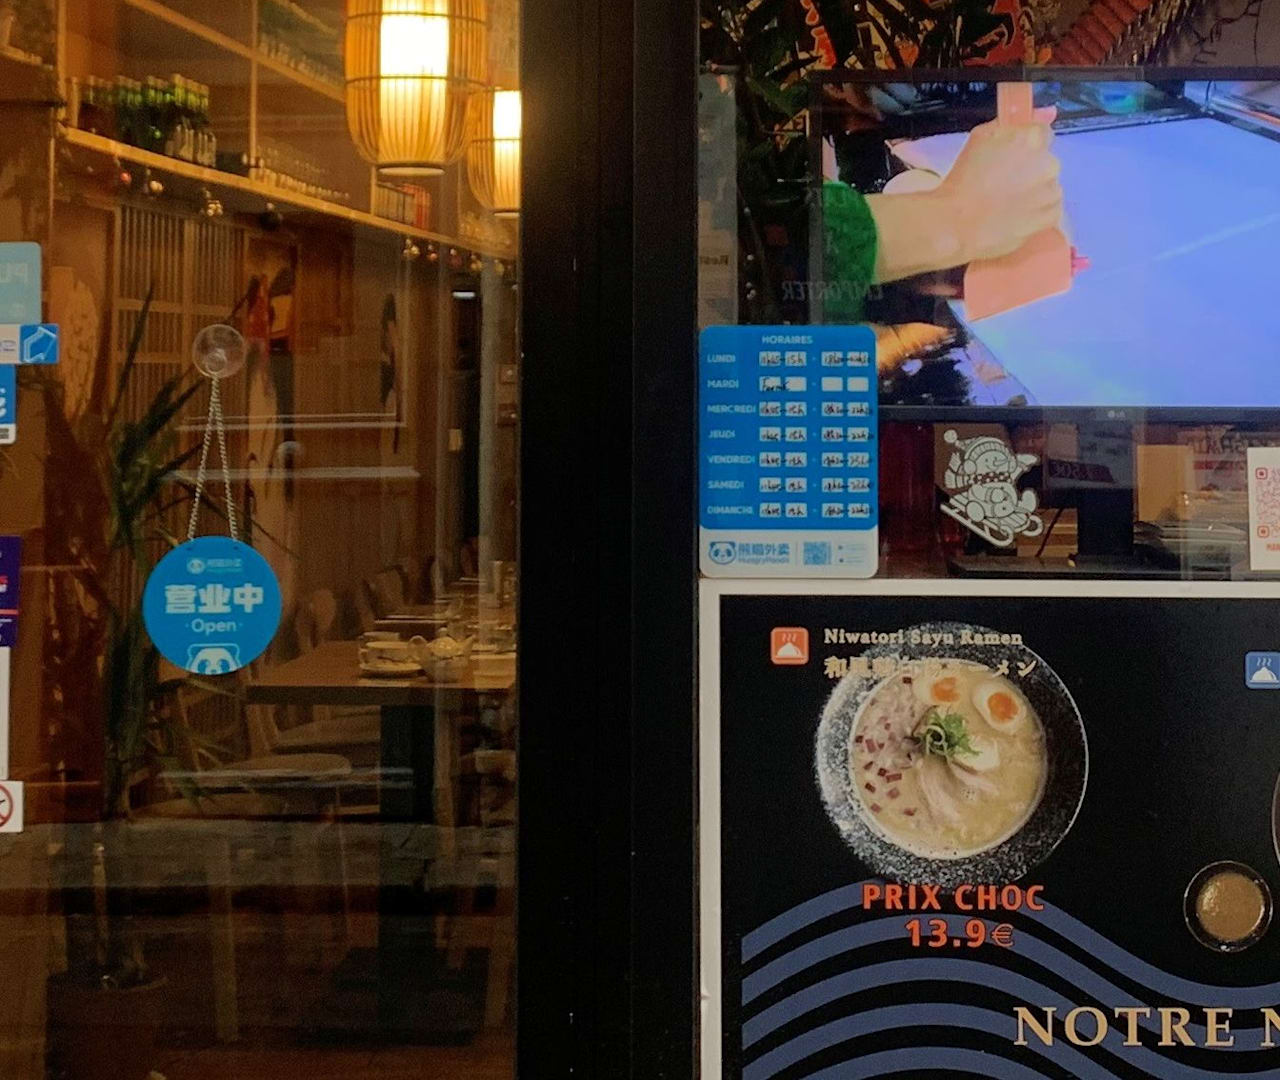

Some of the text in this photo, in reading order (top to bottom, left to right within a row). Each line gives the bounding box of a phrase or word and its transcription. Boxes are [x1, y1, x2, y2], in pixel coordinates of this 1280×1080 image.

[761, 334, 814, 345] HORAIRES
[191, 618, 237, 636] Open
[823, 628, 904, 644] Niwatori
[960, 628, 1023, 645] Ramen
[862, 883, 1046, 912] PRIX CHOC
[904, 920, 1015, 949] 13.9€
[1013, 1005, 1236, 1047] NOTRE
